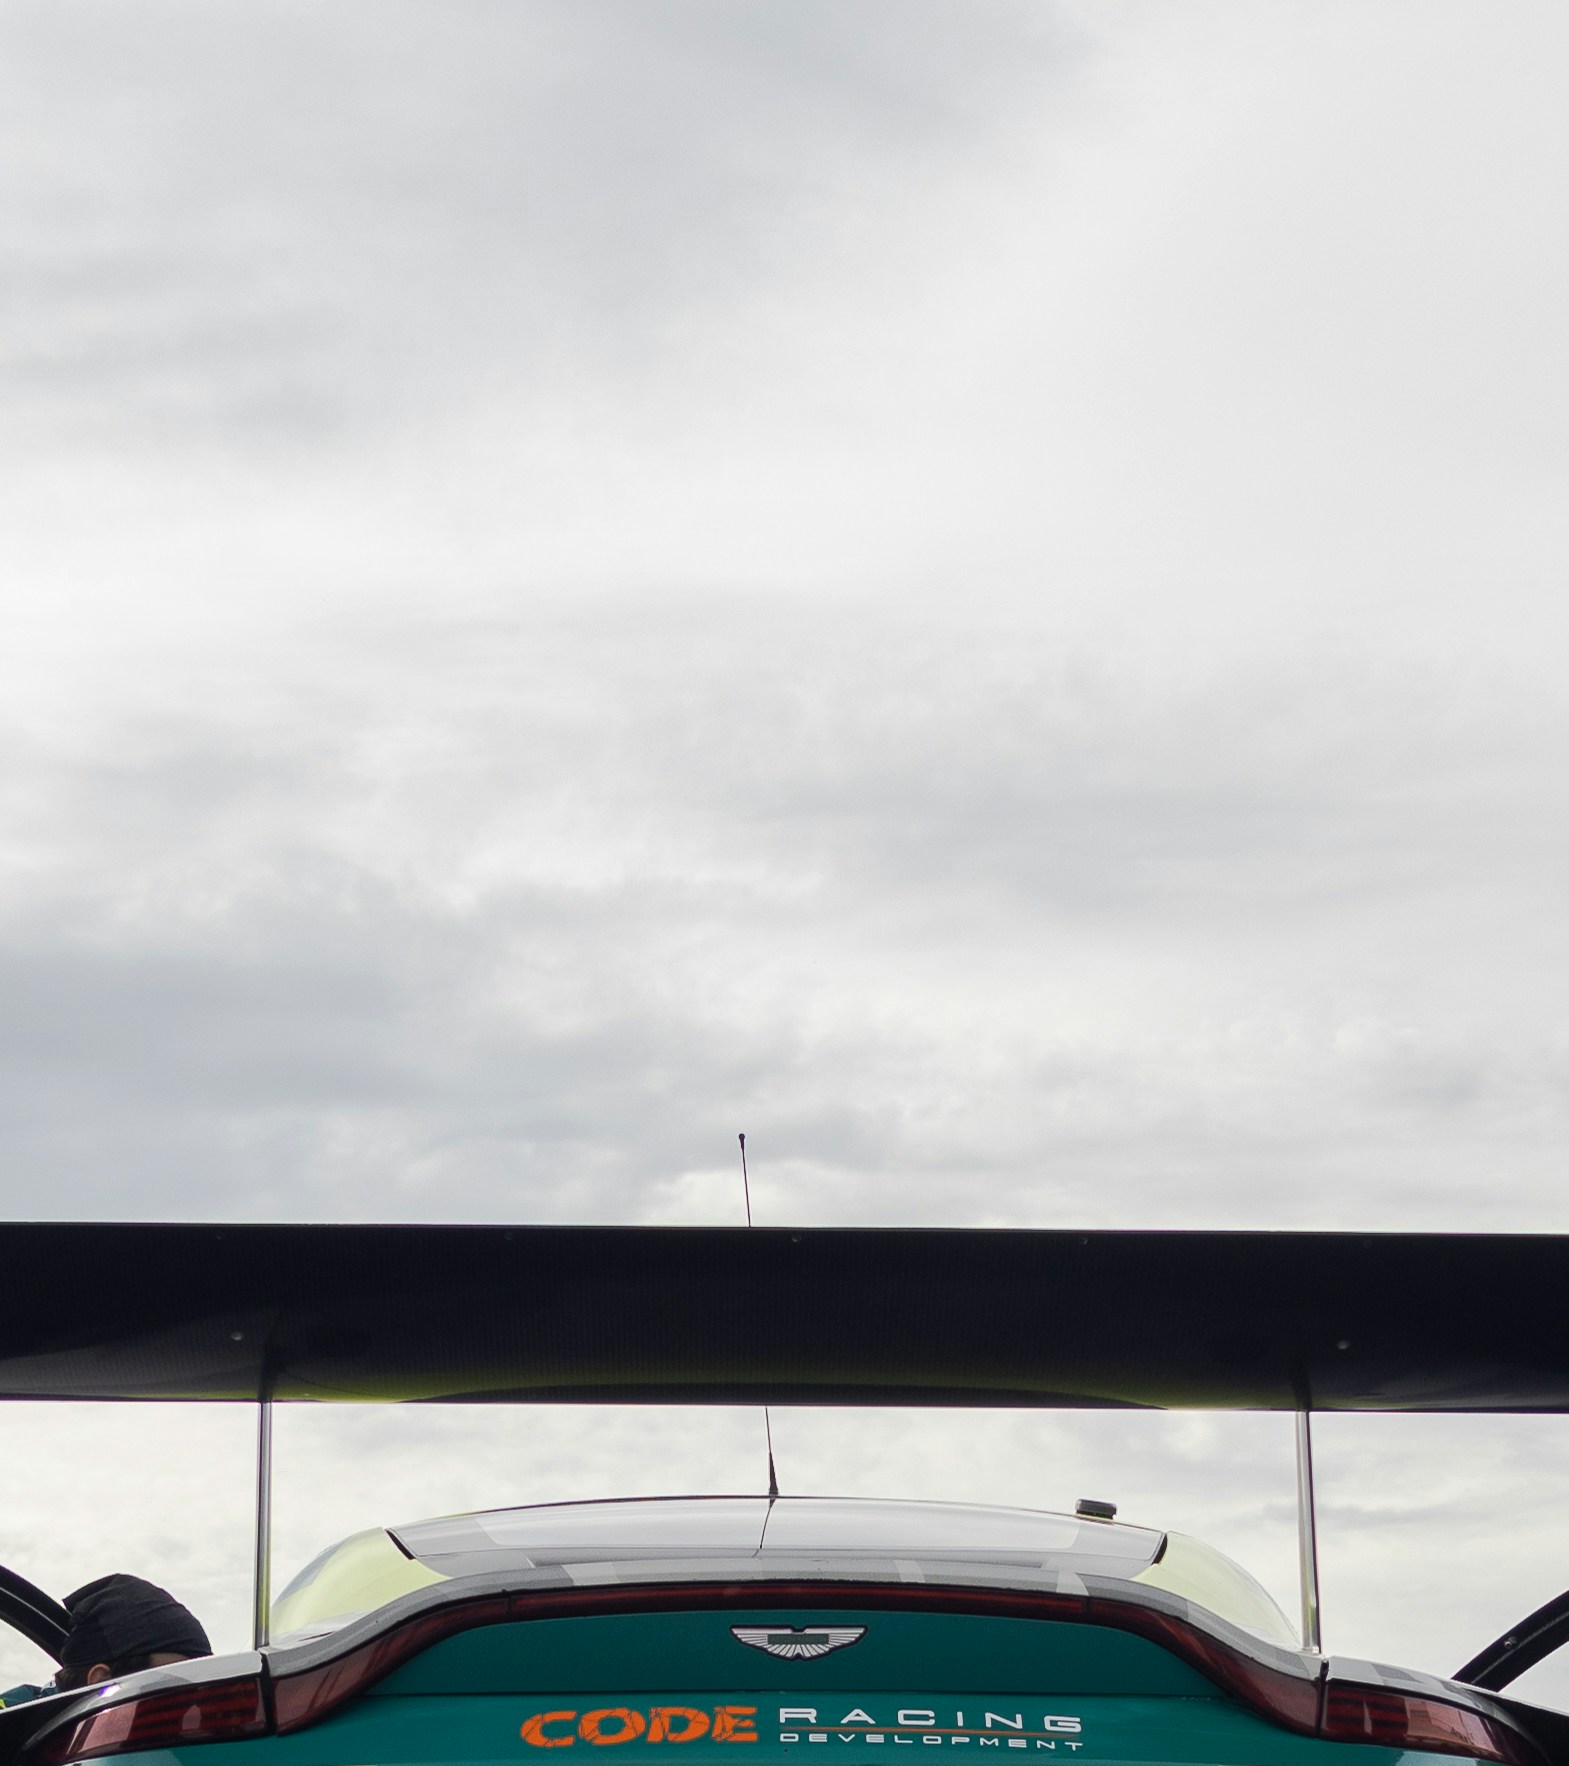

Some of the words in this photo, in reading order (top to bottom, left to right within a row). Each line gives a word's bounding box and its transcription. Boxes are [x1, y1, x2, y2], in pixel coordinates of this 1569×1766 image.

[521, 1705, 759, 1748] CODE
[779, 1707, 1083, 1733] RACING
[779, 1732, 1084, 1751] DEVELOPMENT
